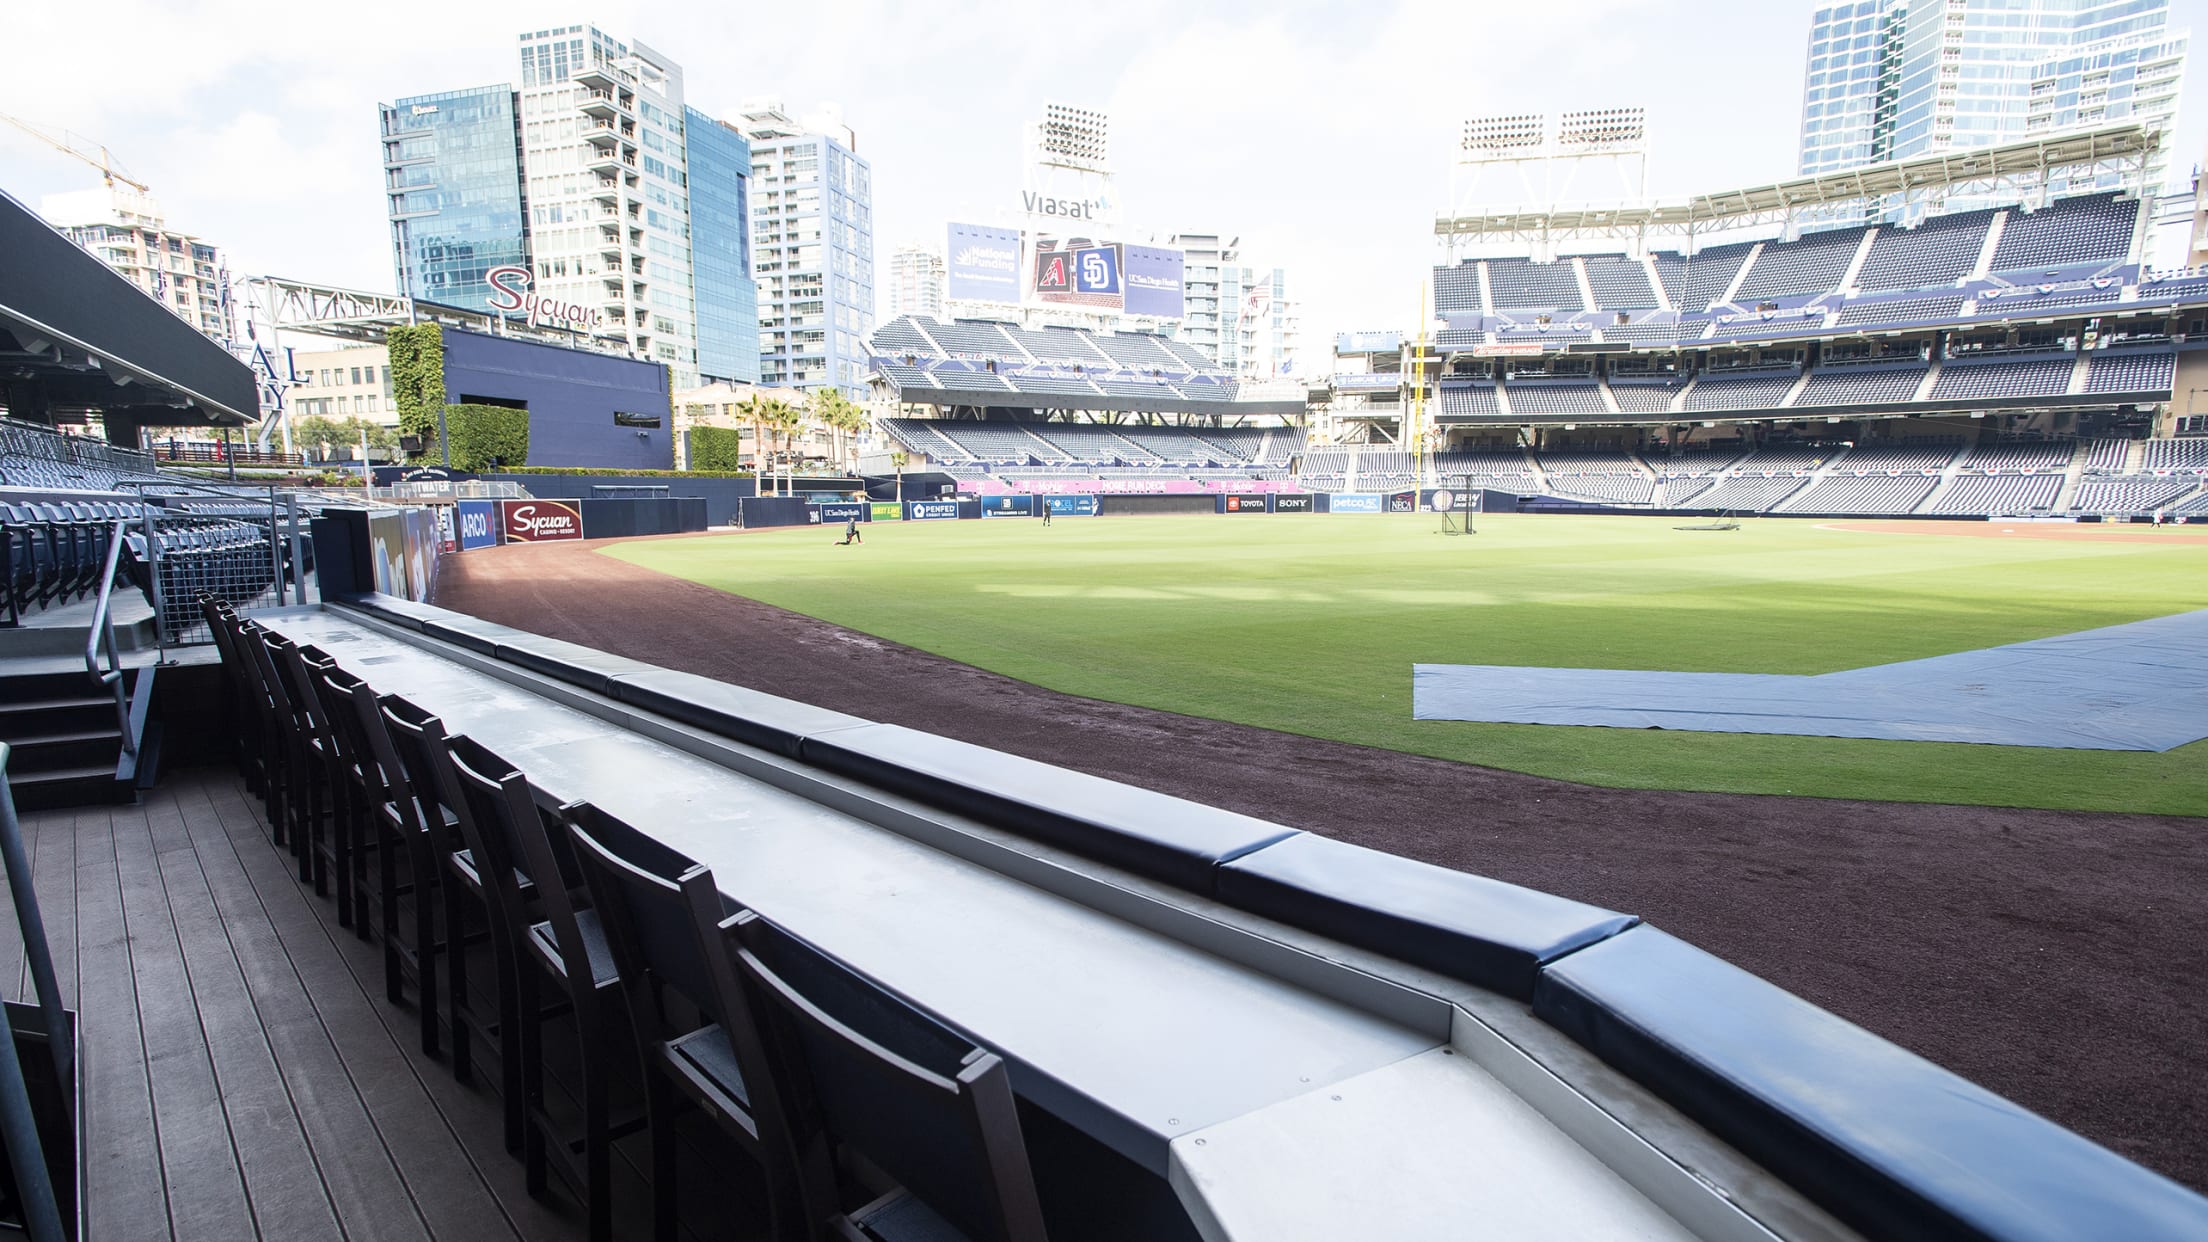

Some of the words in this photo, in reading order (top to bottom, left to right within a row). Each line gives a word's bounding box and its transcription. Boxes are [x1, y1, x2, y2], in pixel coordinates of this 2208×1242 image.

[1022, 190, 1093, 220] Viasat
[972, 246, 1015, 260] National
[972, 257, 1015, 272] Funding
[485, 265, 602, 328] Sycuan
[1103, 481, 1125, 490] HOME
[1128, 481, 1144, 490] RUN
[1145, 481, 1167, 490] DECK
[925, 505, 955, 513] PENFED
[1279, 499, 1307, 507] SONY
[1334, 499, 1364, 509] petco
[462, 513, 486, 538] ARCO
[513, 505, 572, 536] Sycuan
